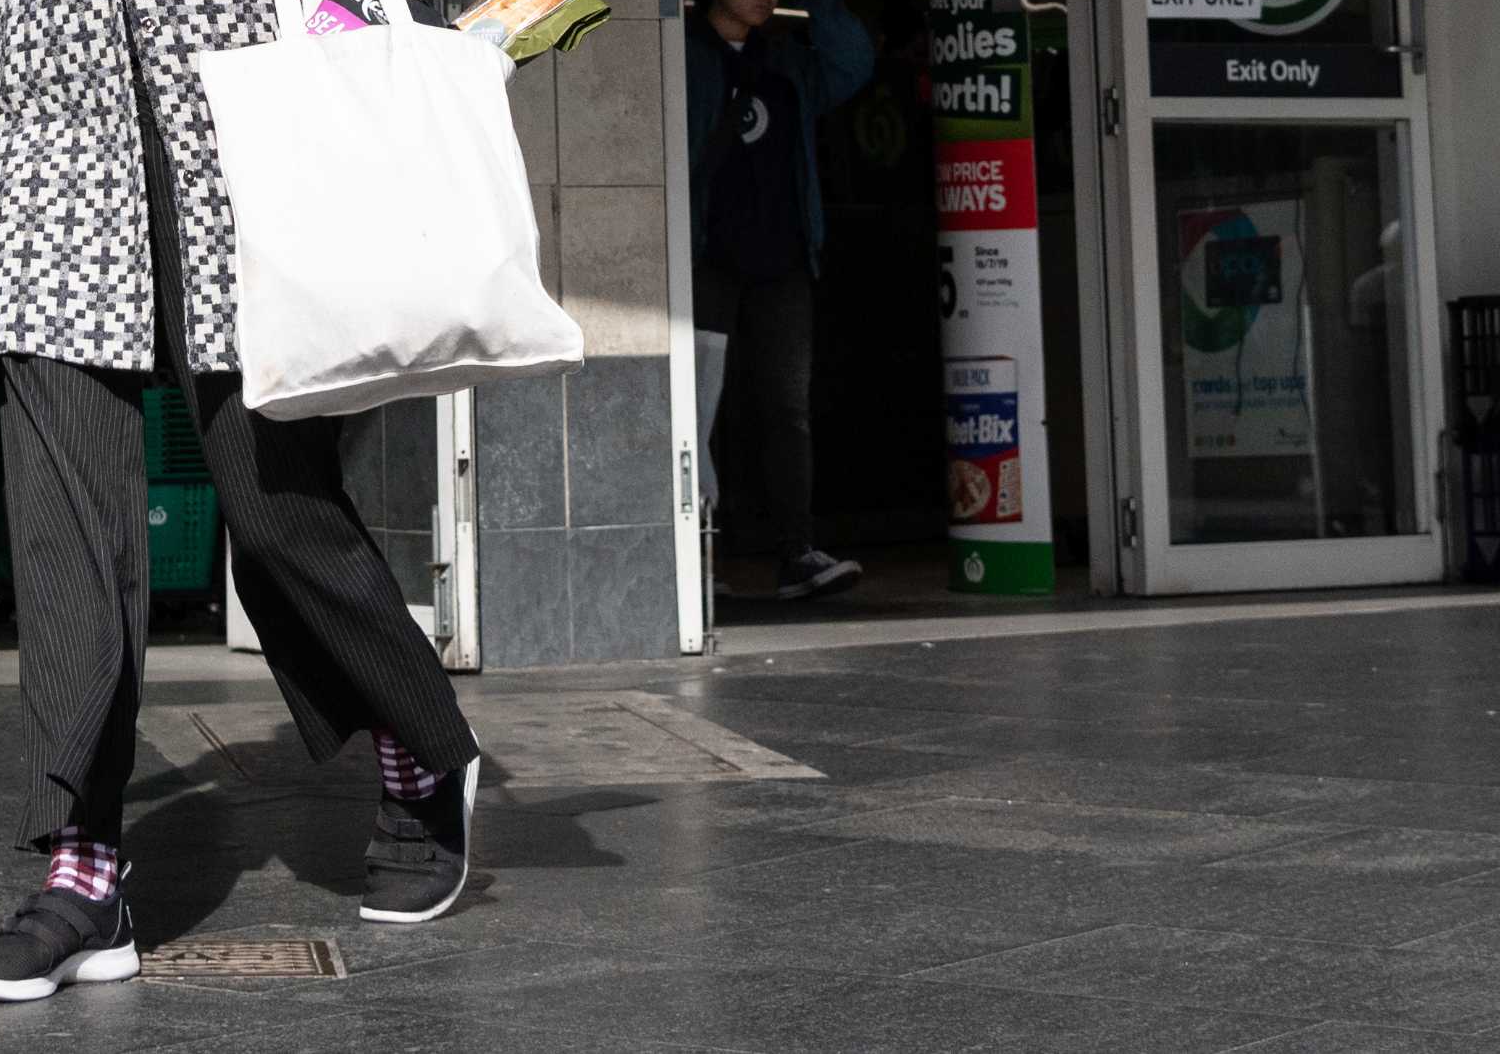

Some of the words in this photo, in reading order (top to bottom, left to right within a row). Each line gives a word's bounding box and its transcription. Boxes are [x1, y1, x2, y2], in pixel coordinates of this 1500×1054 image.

[1225, 59, 1268, 82] Exit
[1269, 59, 1320, 87] Only
[952, 160, 1005, 182] PRICE
[975, 246, 999, 257] Since
